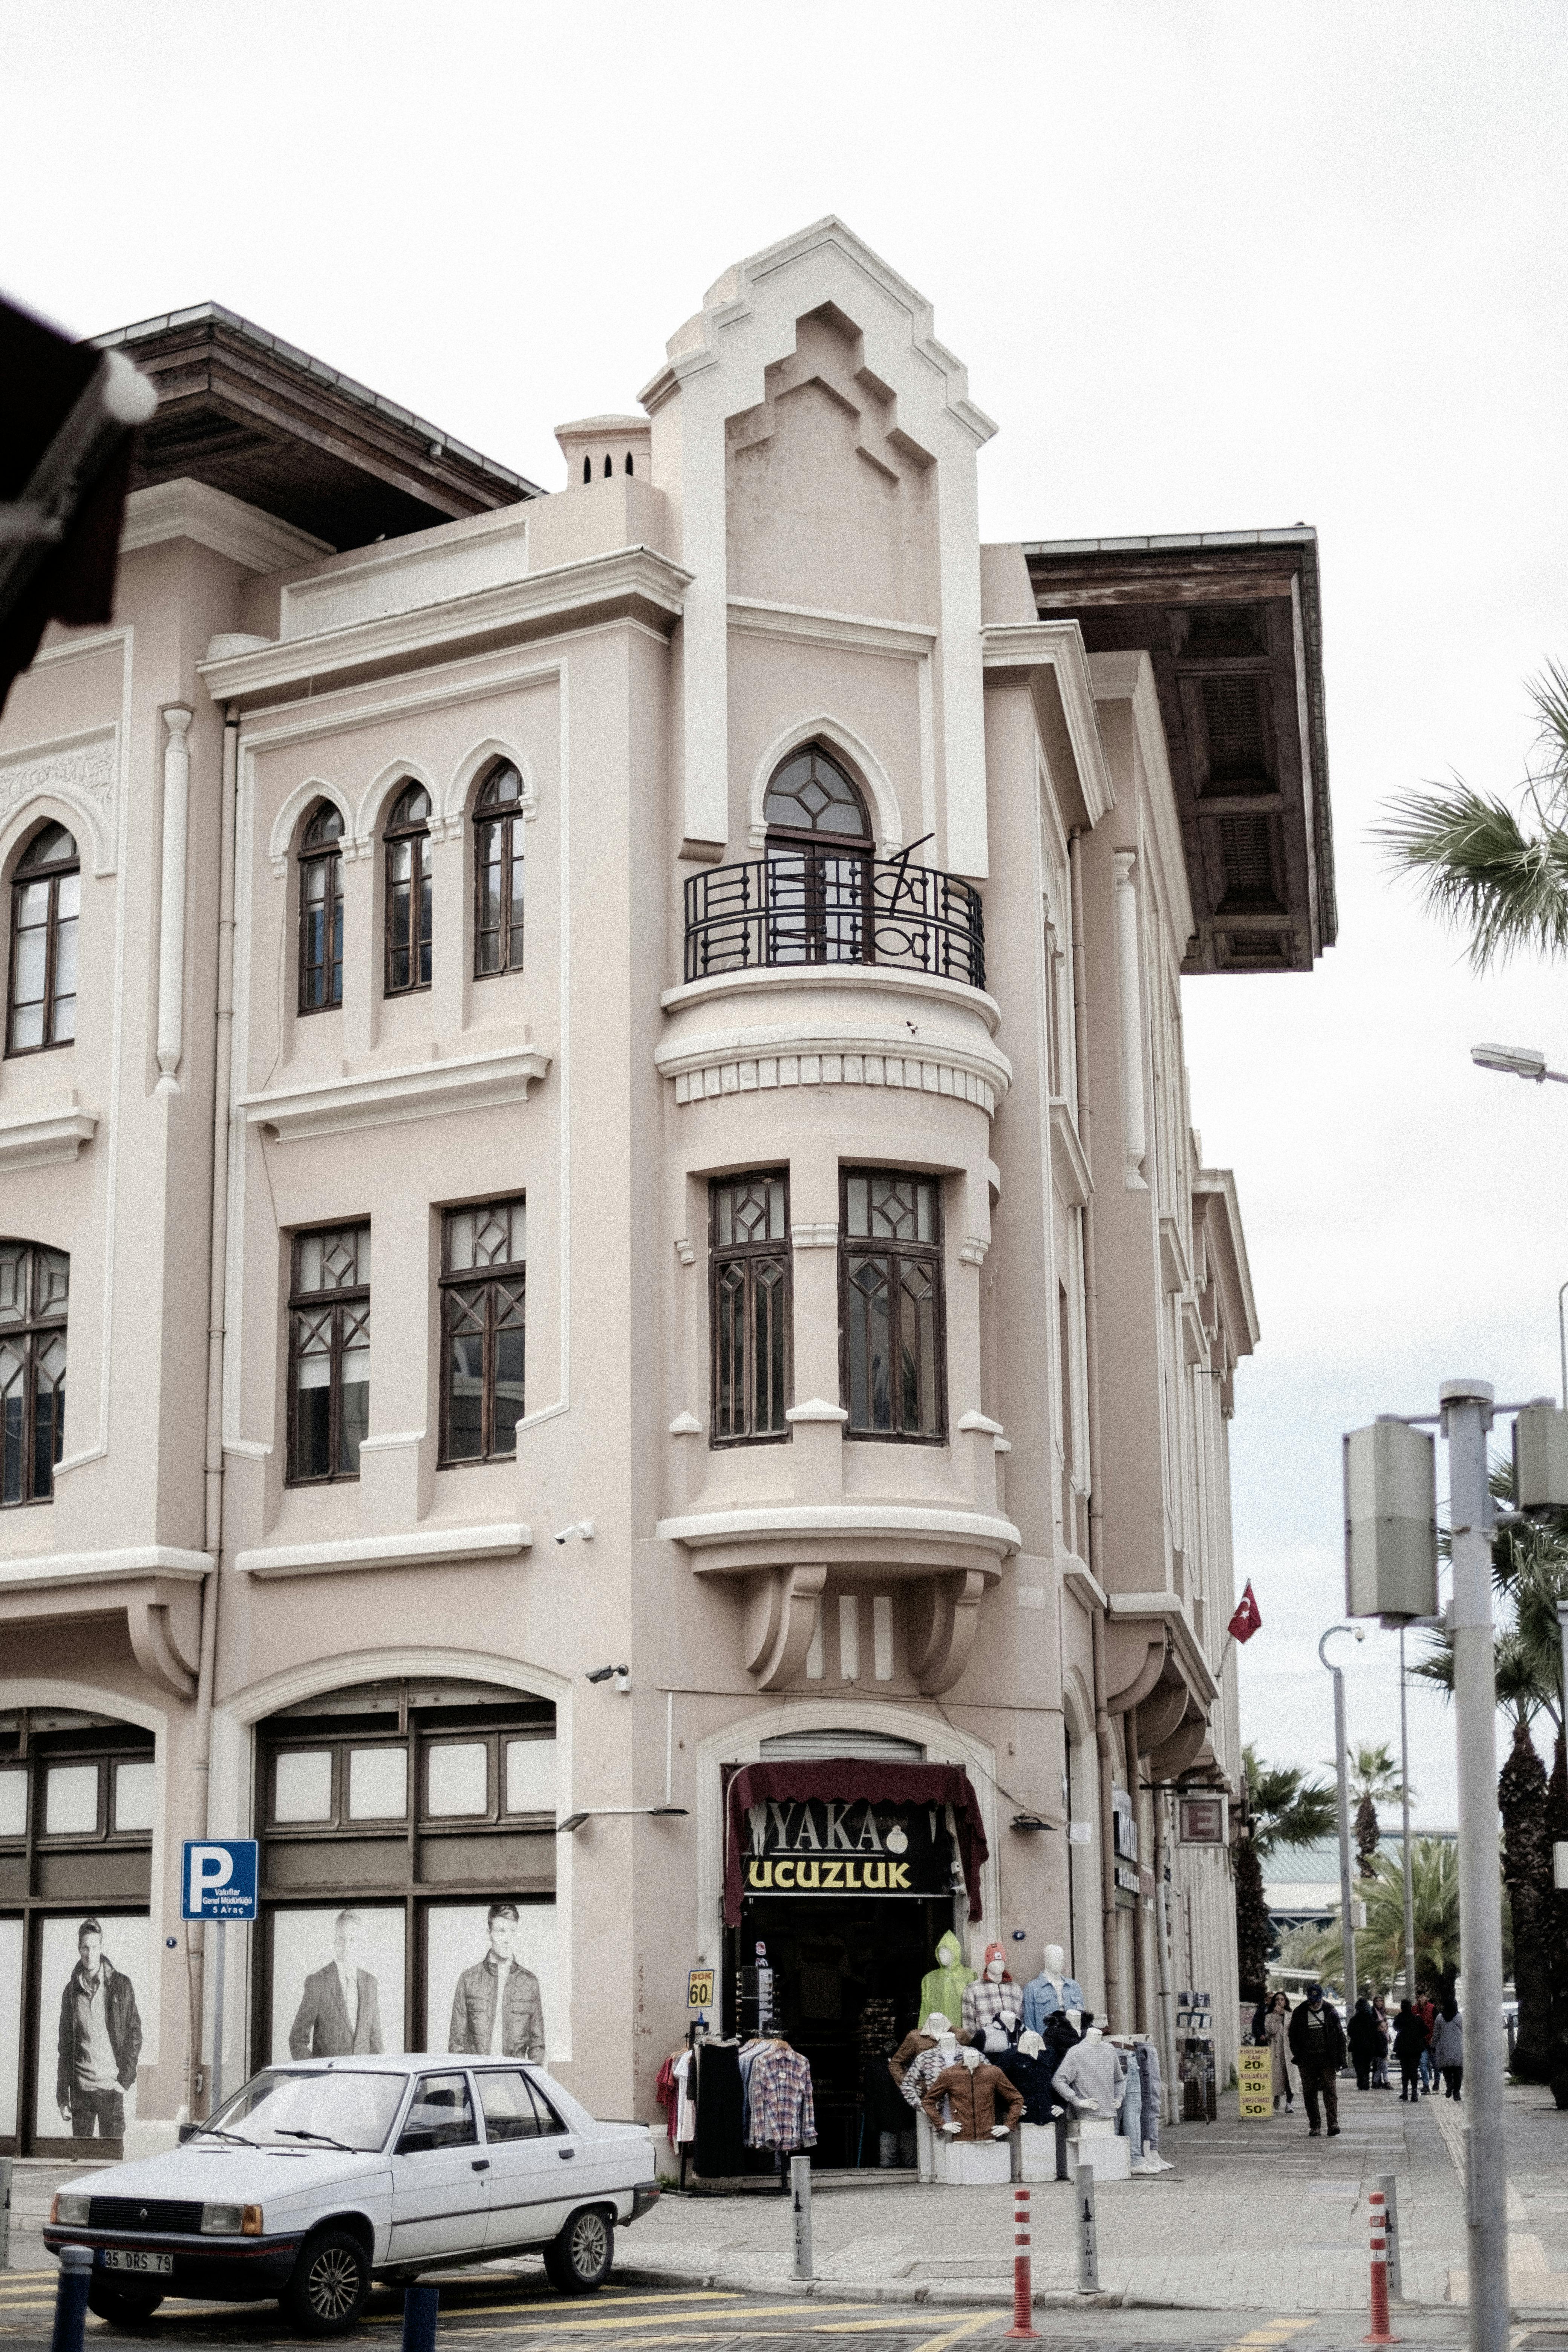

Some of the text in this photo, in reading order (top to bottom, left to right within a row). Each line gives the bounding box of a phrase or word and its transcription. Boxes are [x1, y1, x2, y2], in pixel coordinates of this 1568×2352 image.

[768, 1802, 884, 1851] YAKA
[190, 1847, 233, 1913] P
[749, 1860, 912, 1889] UCUZLUK
[221, 1906, 244, 1915] Araç
[106, 2251, 171, 2271] 35 DRS 79
